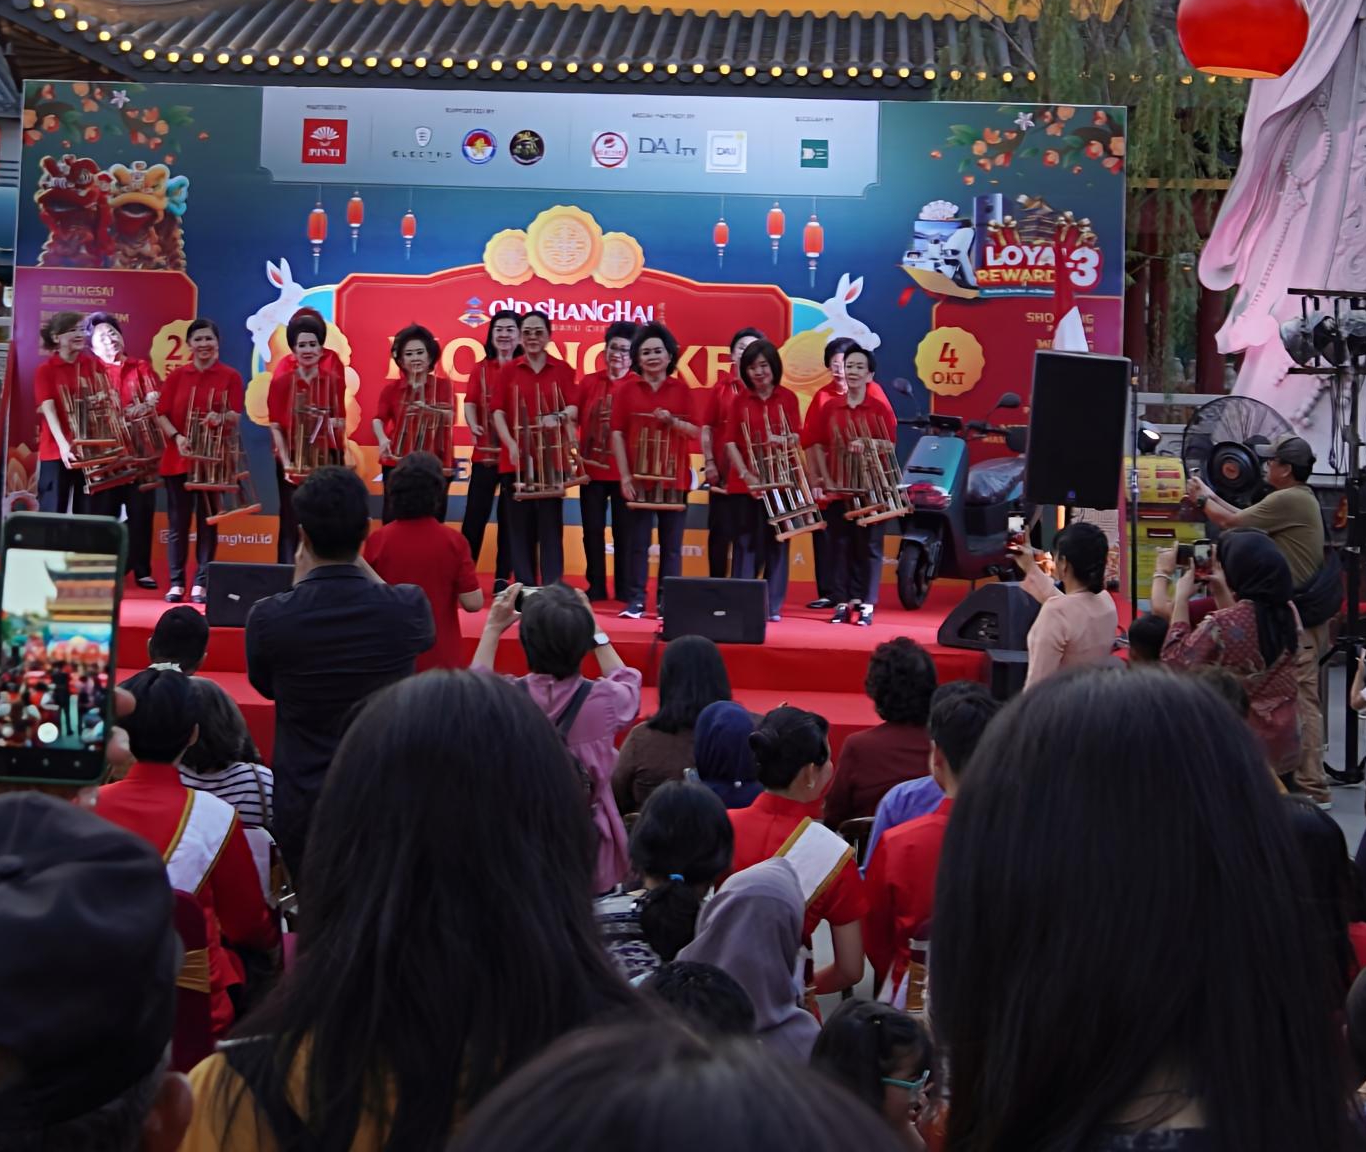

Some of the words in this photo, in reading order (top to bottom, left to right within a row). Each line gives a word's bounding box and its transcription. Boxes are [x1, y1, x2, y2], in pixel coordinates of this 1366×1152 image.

[533, 298, 654, 326] SHANGHAI
[938, 342, 959, 369] 4
[931, 371, 966, 385] OKT
